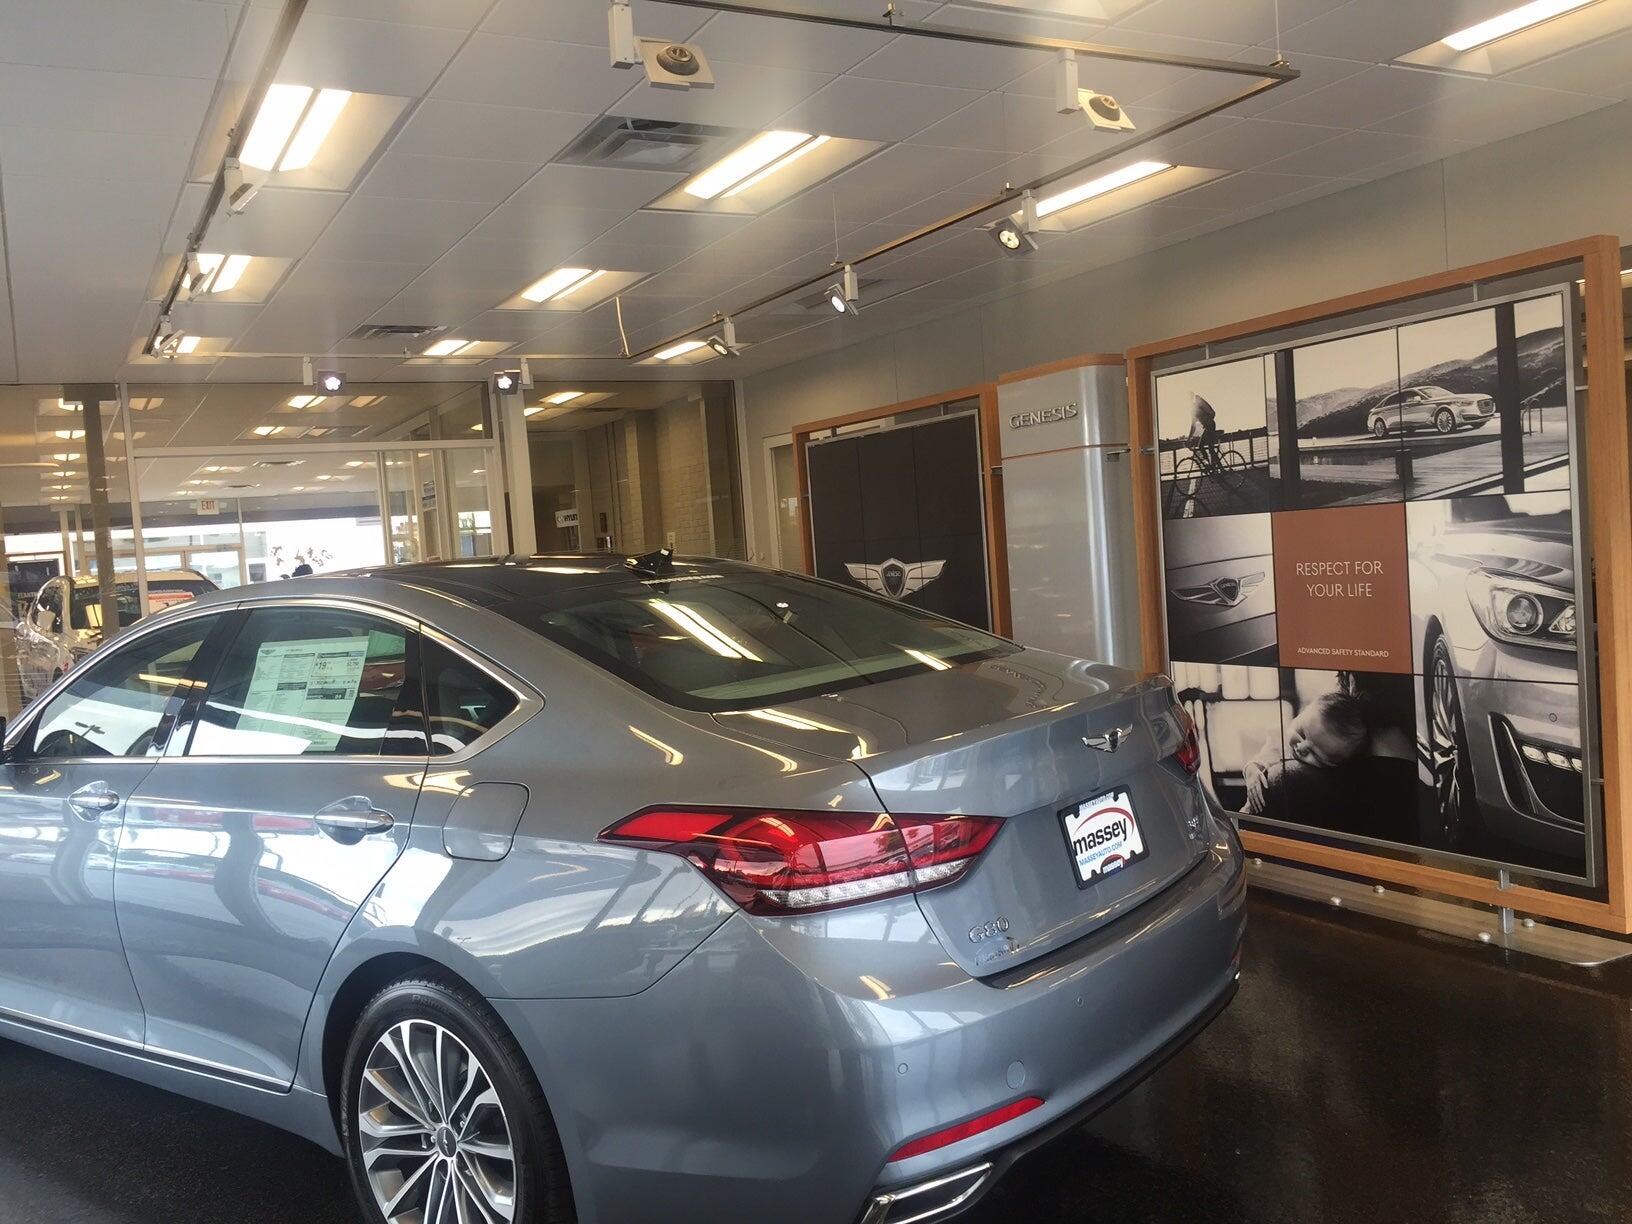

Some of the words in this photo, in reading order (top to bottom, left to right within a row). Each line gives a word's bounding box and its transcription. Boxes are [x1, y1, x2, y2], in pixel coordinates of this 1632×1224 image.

[1009, 403, 1079, 429] GENESIS
[201, 500, 215, 511] EXIT
[1296, 561, 1351, 576] RESPECT
[1354, 560, 1384, 575] FOR
[1306, 583, 1345, 597] YOUR
[1347, 583, 1373, 597] LIFE
[1297, 646, 1331, 656] ADVANCED
[1331, 647, 1354, 657] SAFETY
[1354, 649, 1390, 658] STANDARD
[1072, 818, 1128, 856] massey
[1079, 841, 1123, 867] MASSEYAUTO.COM
[968, 916, 1010, 944] G80
